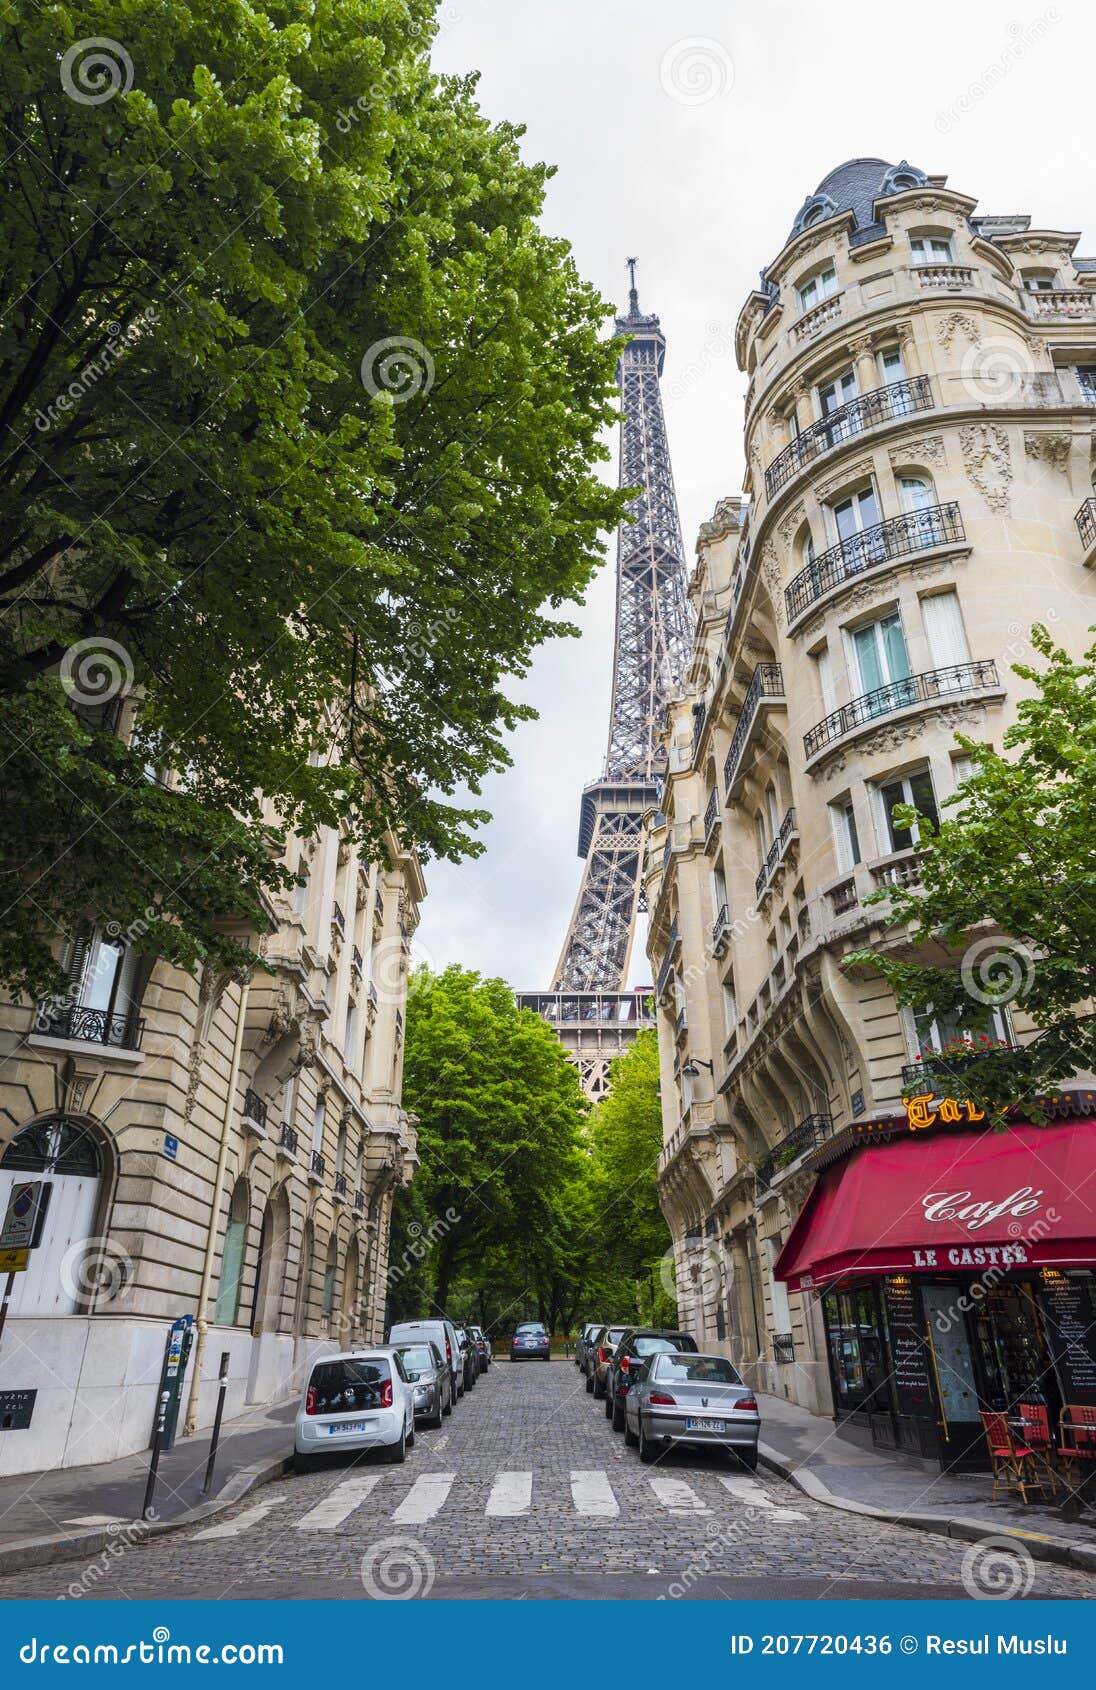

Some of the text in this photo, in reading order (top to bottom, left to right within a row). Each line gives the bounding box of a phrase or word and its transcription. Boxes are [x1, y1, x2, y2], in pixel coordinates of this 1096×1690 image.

[922, 1186, 1044, 1230] Café
[913, 1245, 1028, 1267] LE CASTEL
